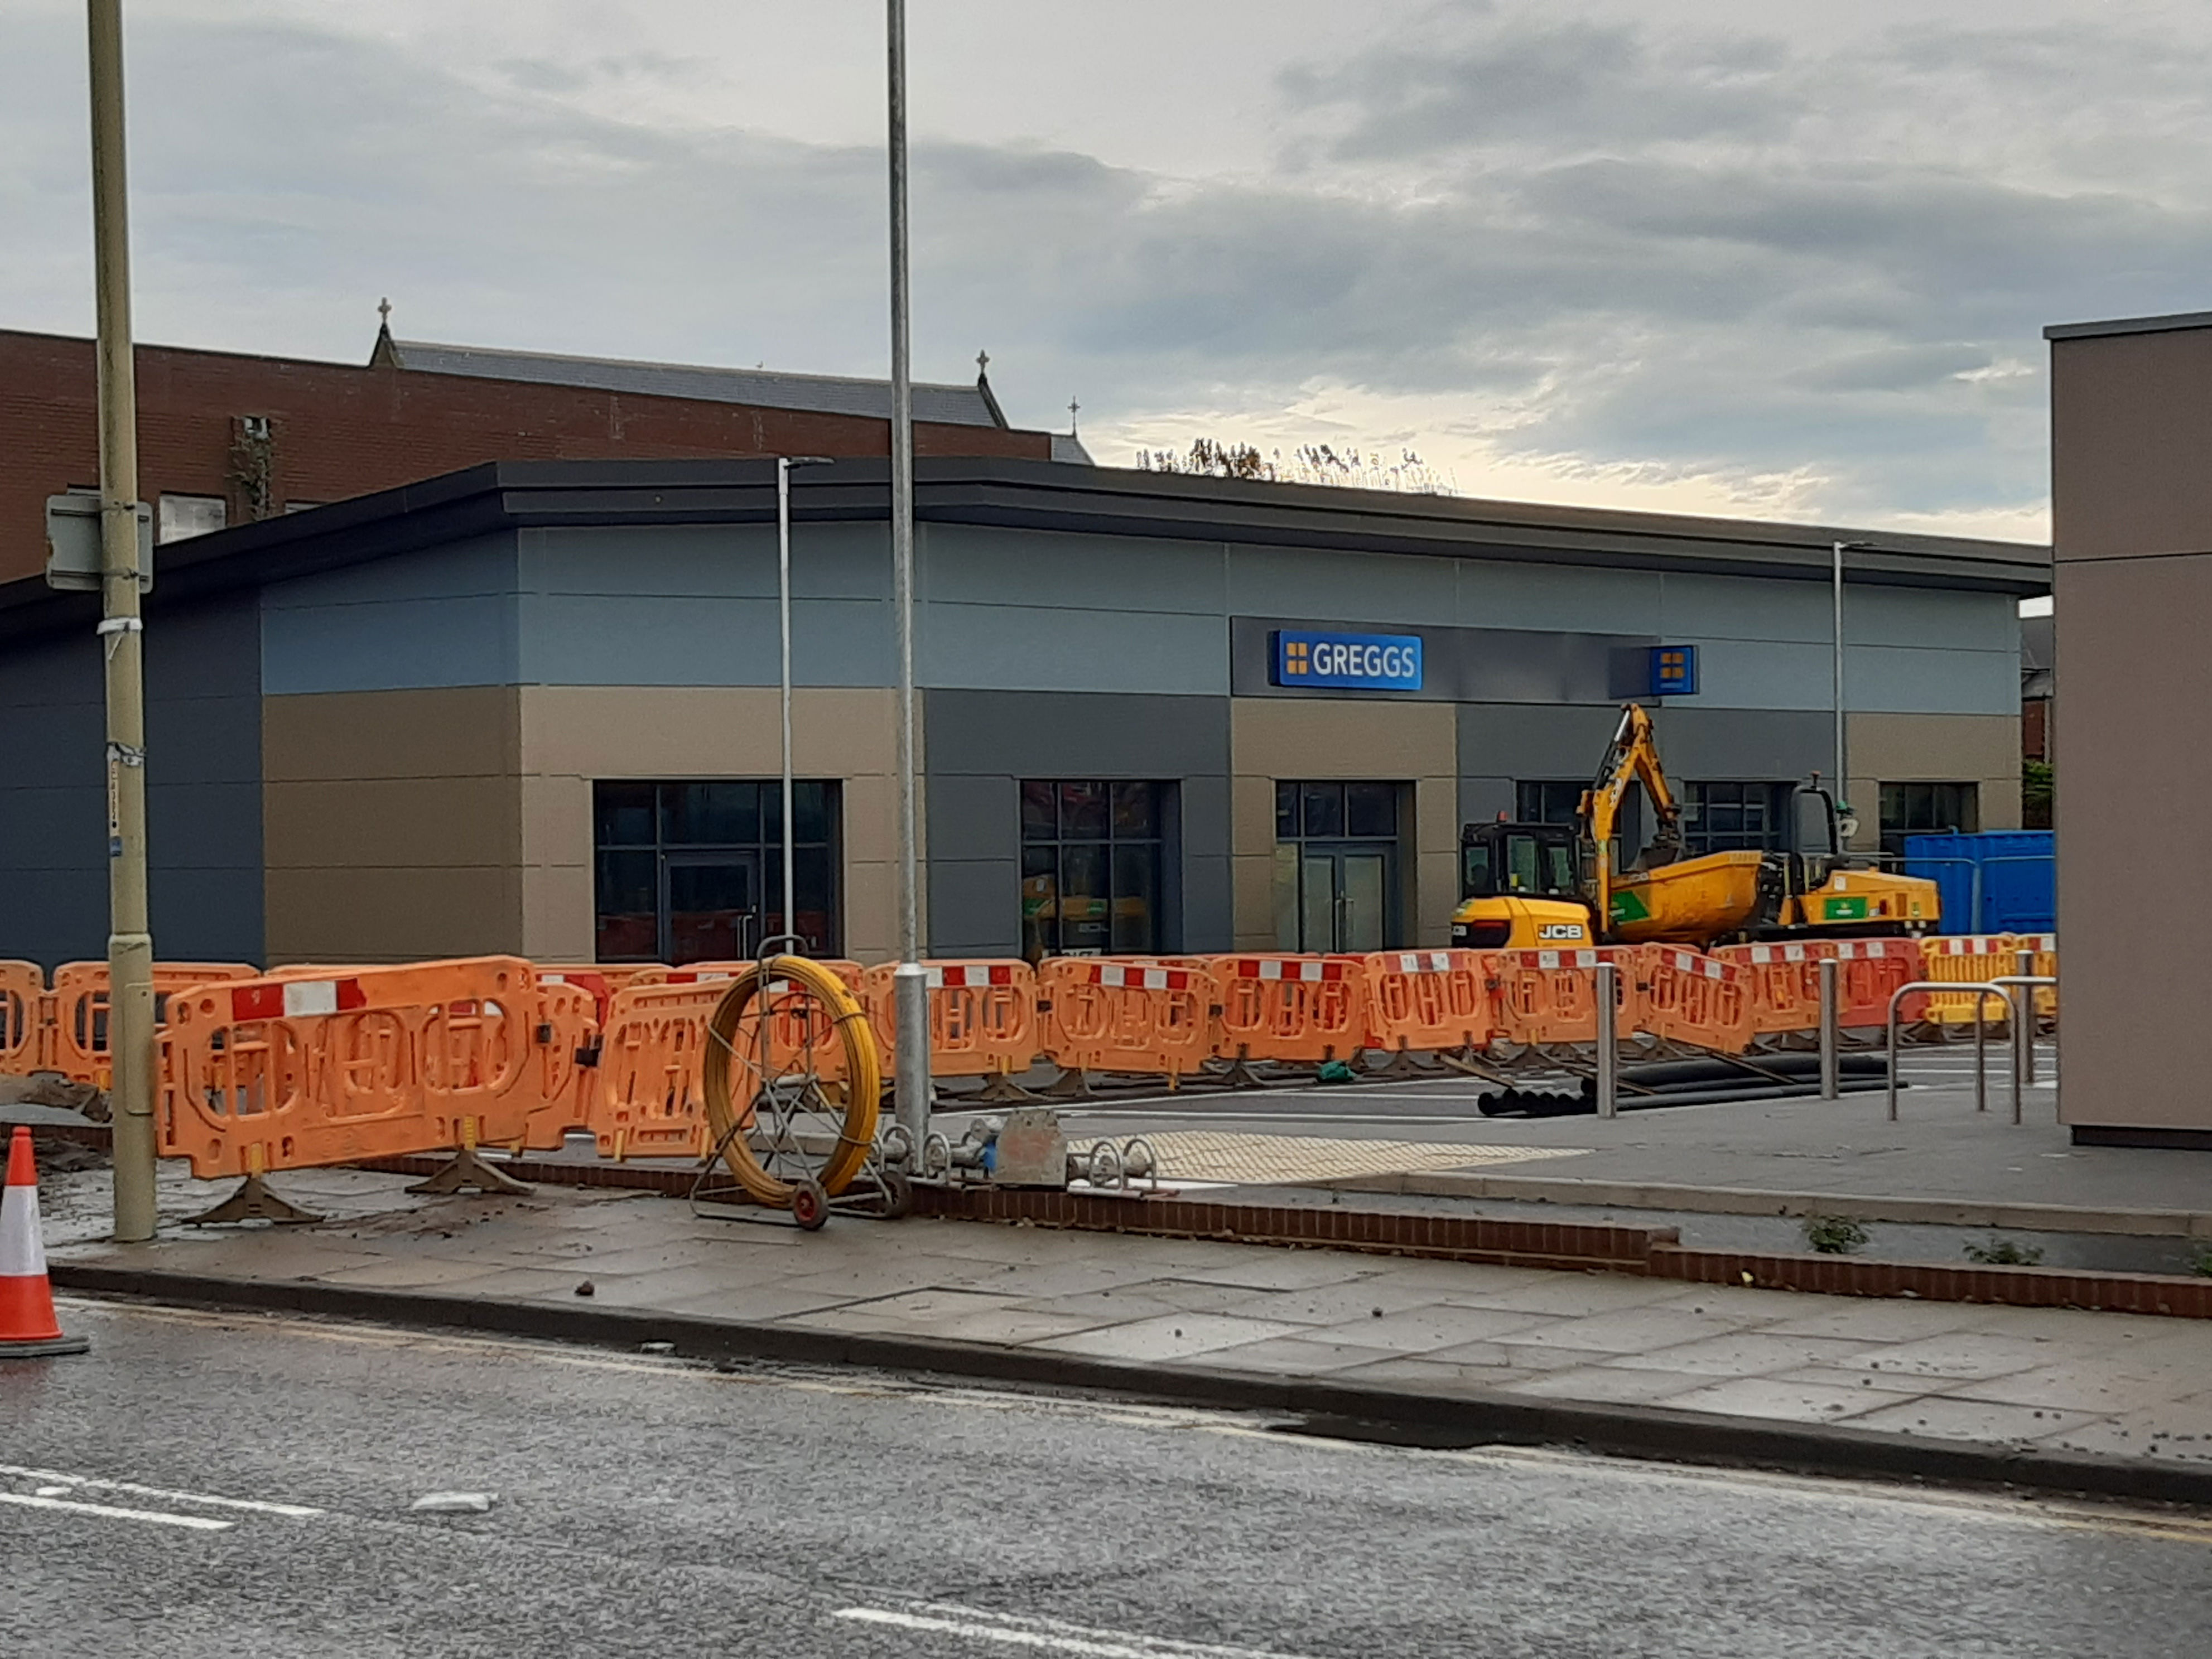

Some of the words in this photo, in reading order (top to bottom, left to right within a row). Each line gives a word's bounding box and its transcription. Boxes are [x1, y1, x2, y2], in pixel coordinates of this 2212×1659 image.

[1313, 642, 1415, 678] GREGGS
[1452, 925, 1467, 935] CB
[1538, 924, 1582, 939] JCB
